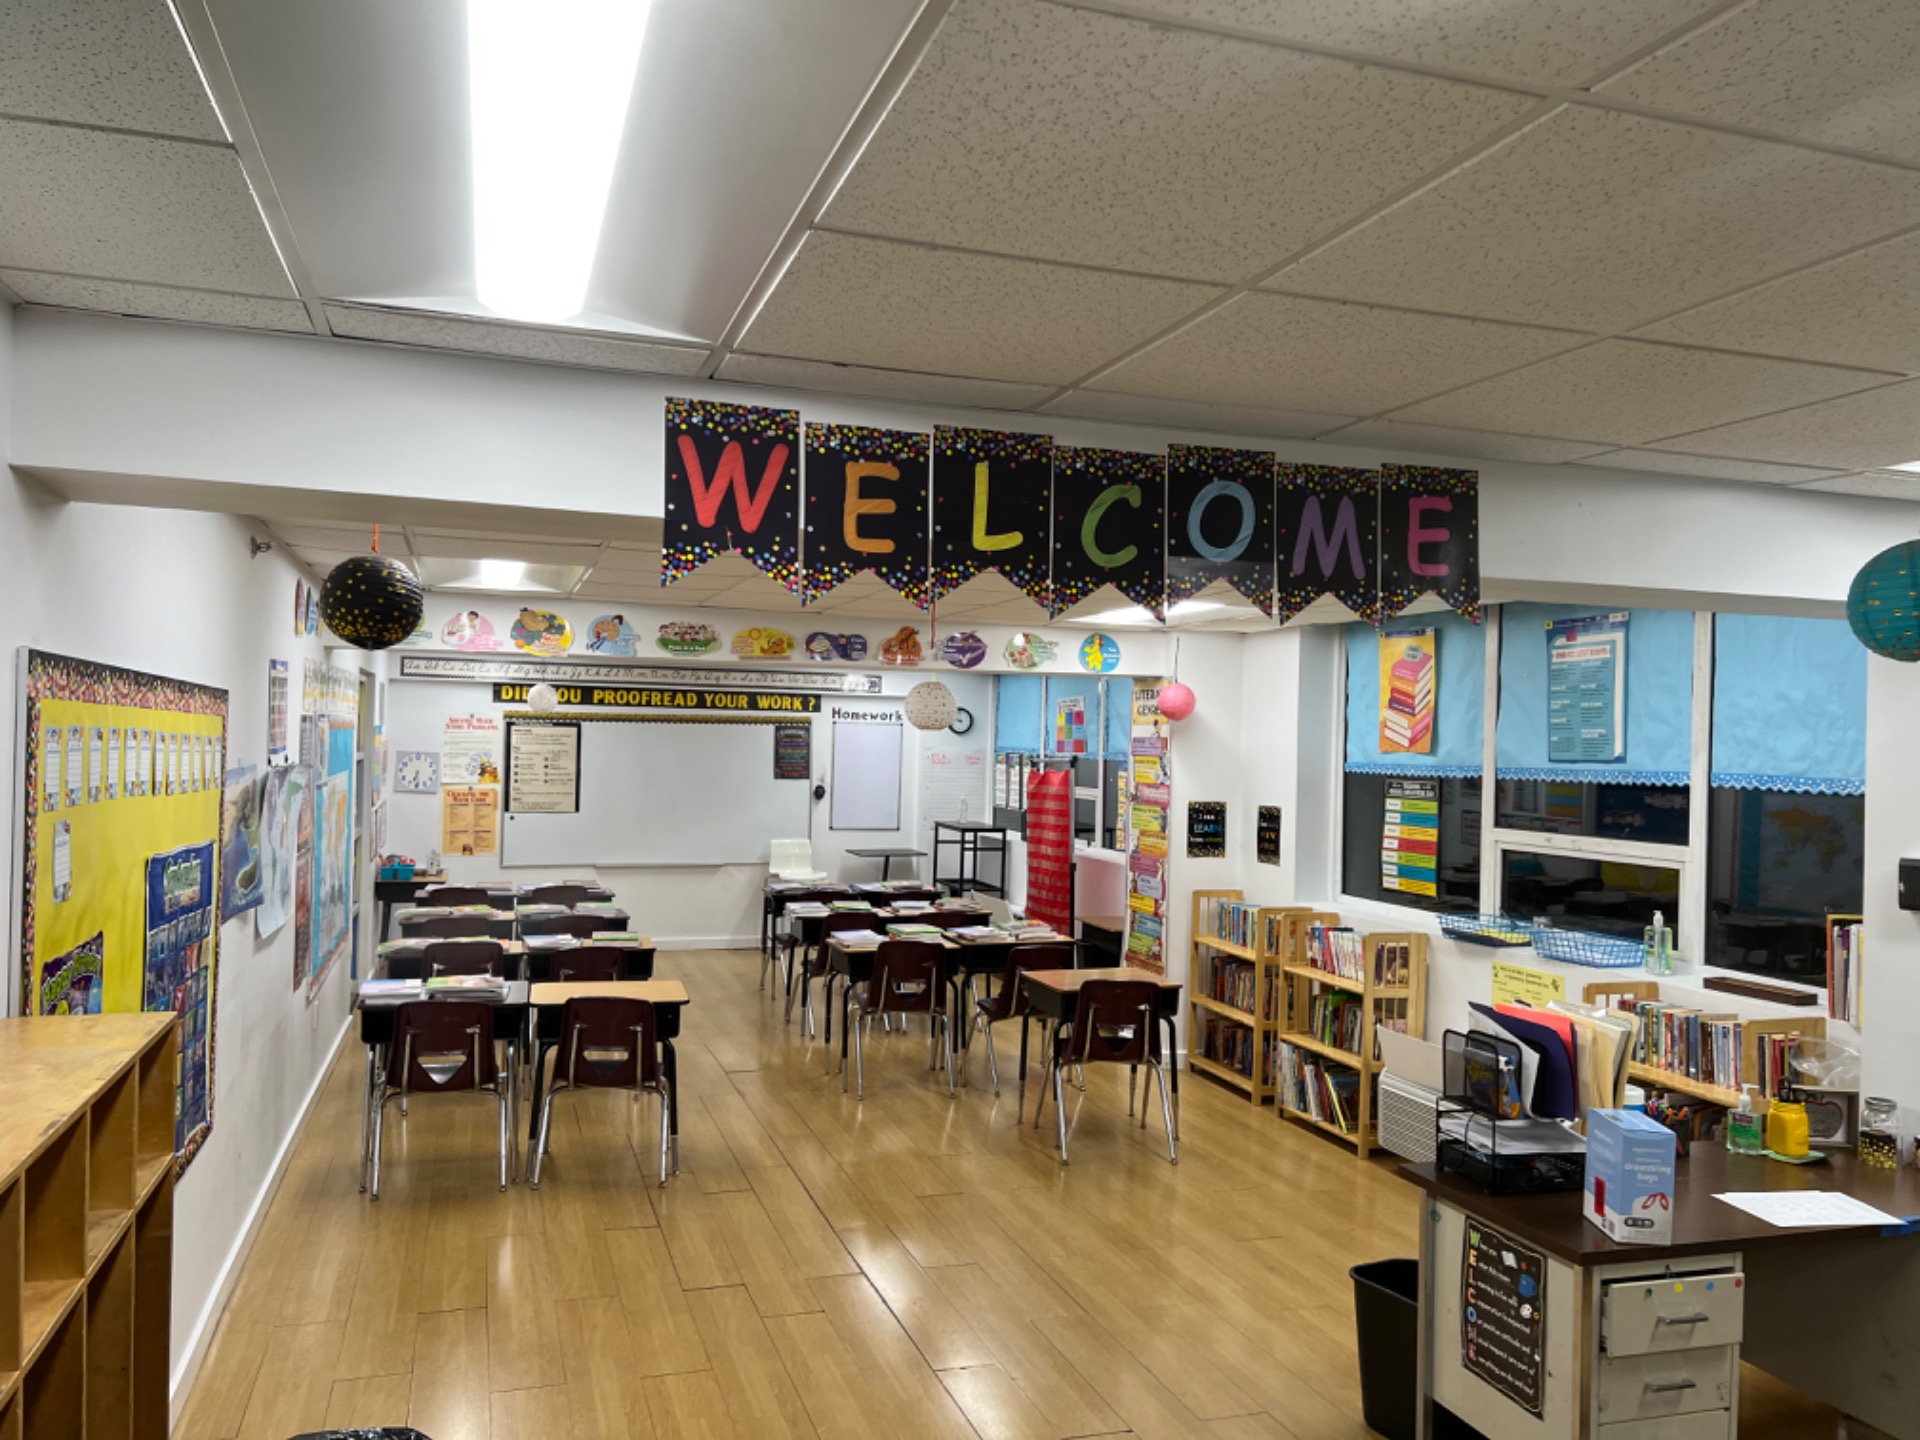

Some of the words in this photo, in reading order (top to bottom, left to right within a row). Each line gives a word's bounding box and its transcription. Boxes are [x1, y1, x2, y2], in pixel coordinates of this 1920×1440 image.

[677, 434, 1453, 580] WELCOME
[557, 687, 581, 703] OU
[593, 689, 698, 707] PROOFREAD
[704, 692, 748, 709] YOUR
[756, 694, 803, 711] WORK
[832, 707, 904, 722] Homework
[1624, 1162, 1671, 1175] drawstring
[1637, 1173, 1658, 1183] bags
